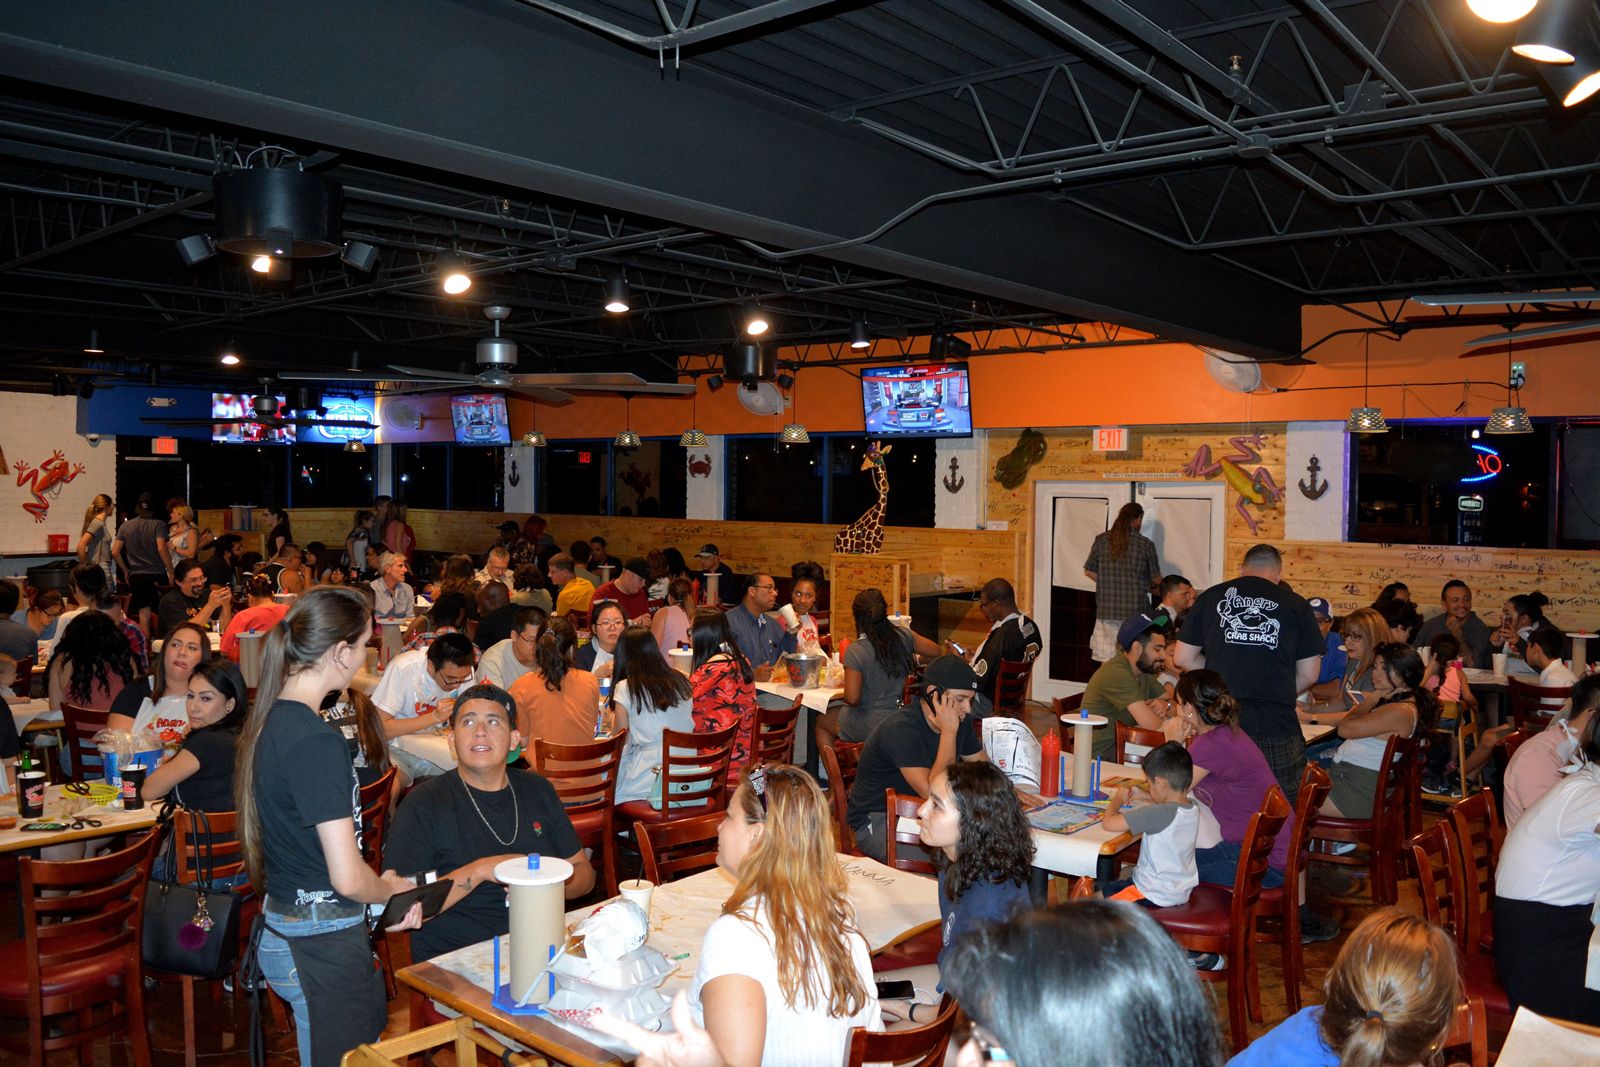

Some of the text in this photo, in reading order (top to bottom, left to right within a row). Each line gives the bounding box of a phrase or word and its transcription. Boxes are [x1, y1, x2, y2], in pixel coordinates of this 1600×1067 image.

[1098, 429, 1123, 449] EXIT
[1232, 595, 1279, 611] Angry
[1227, 631, 1276, 644] CRAB SHACK
